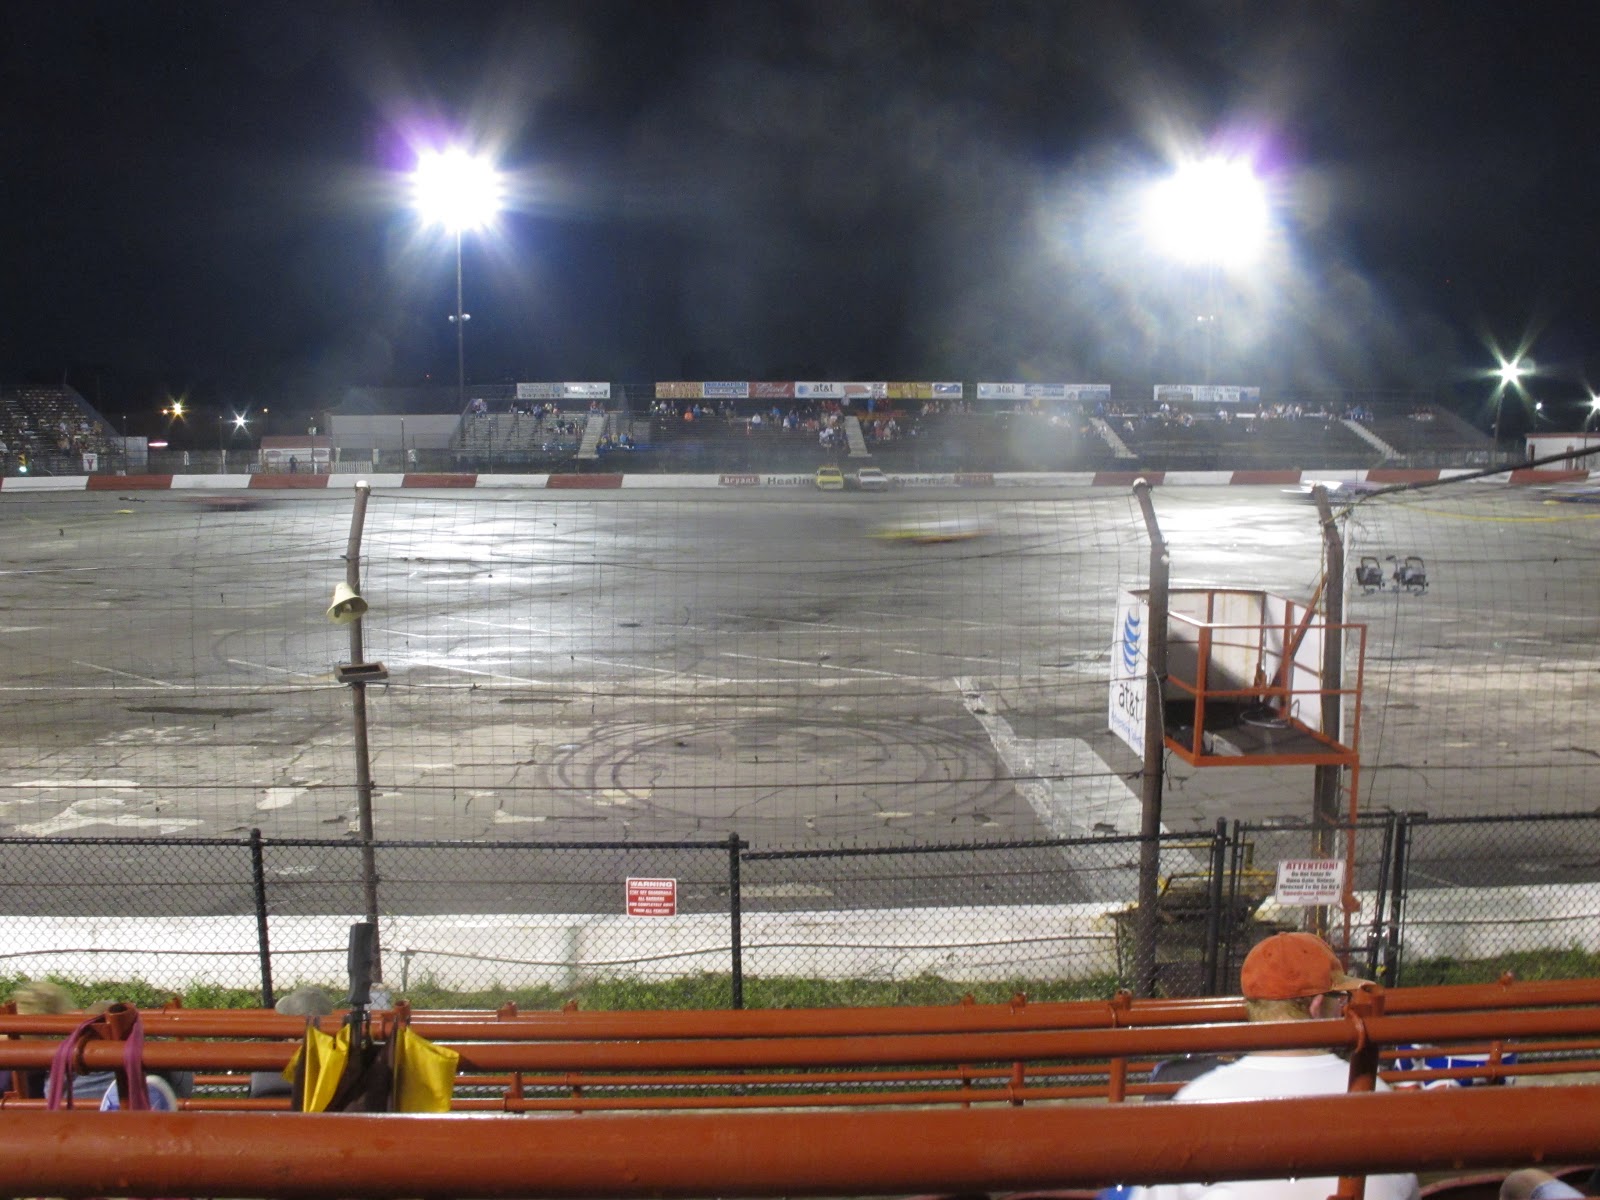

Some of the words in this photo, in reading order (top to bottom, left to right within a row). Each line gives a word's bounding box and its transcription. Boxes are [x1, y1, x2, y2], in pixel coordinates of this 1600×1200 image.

[813, 383, 833, 393] at&t
[767, 476, 817, 486] Heatin
[1118, 682, 1140, 724] at&t
[1286, 862, 1338, 870] ATTENTION!
